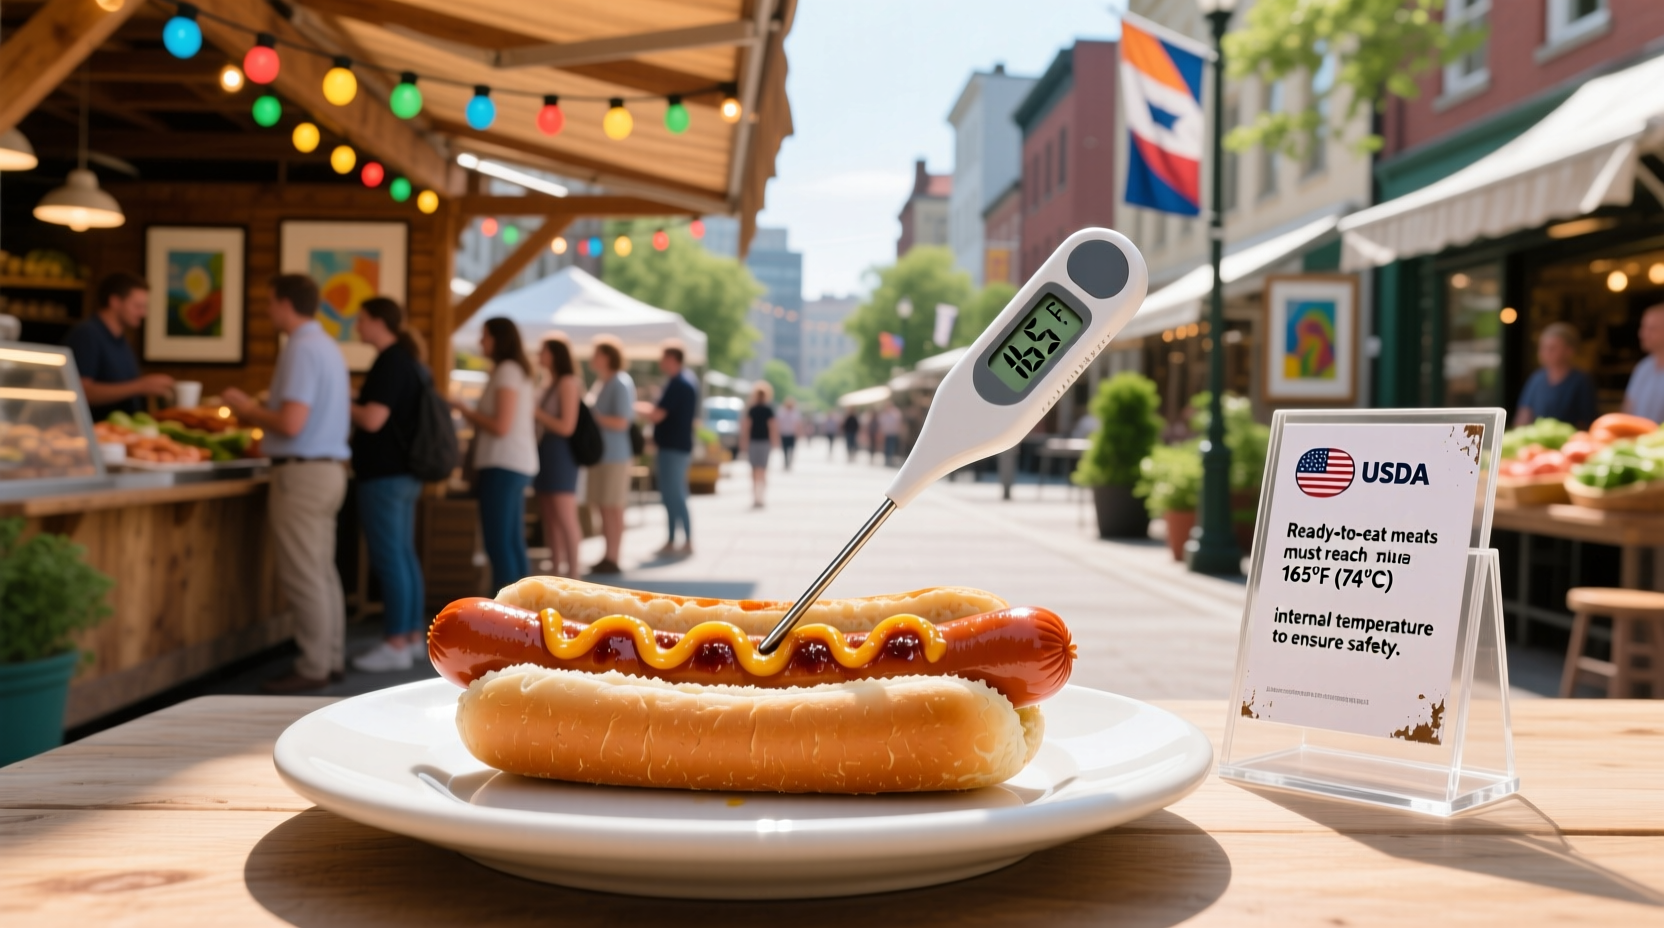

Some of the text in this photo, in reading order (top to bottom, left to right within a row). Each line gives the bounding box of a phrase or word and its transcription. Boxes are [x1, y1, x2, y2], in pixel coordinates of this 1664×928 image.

[1002, 317, 1061, 380] 165
[1361, 461, 1430, 486] USDA
[1286, 522, 1438, 545] Ready-to-eat meats
[1283, 545, 1323, 561] must
[1324, 546, 1368, 563] reach
[1281, 564, 1394, 594] 165°F (74°C)
[1273, 606, 1434, 637] internal temperature
[1272, 629, 1401, 660] to ensure safety.
